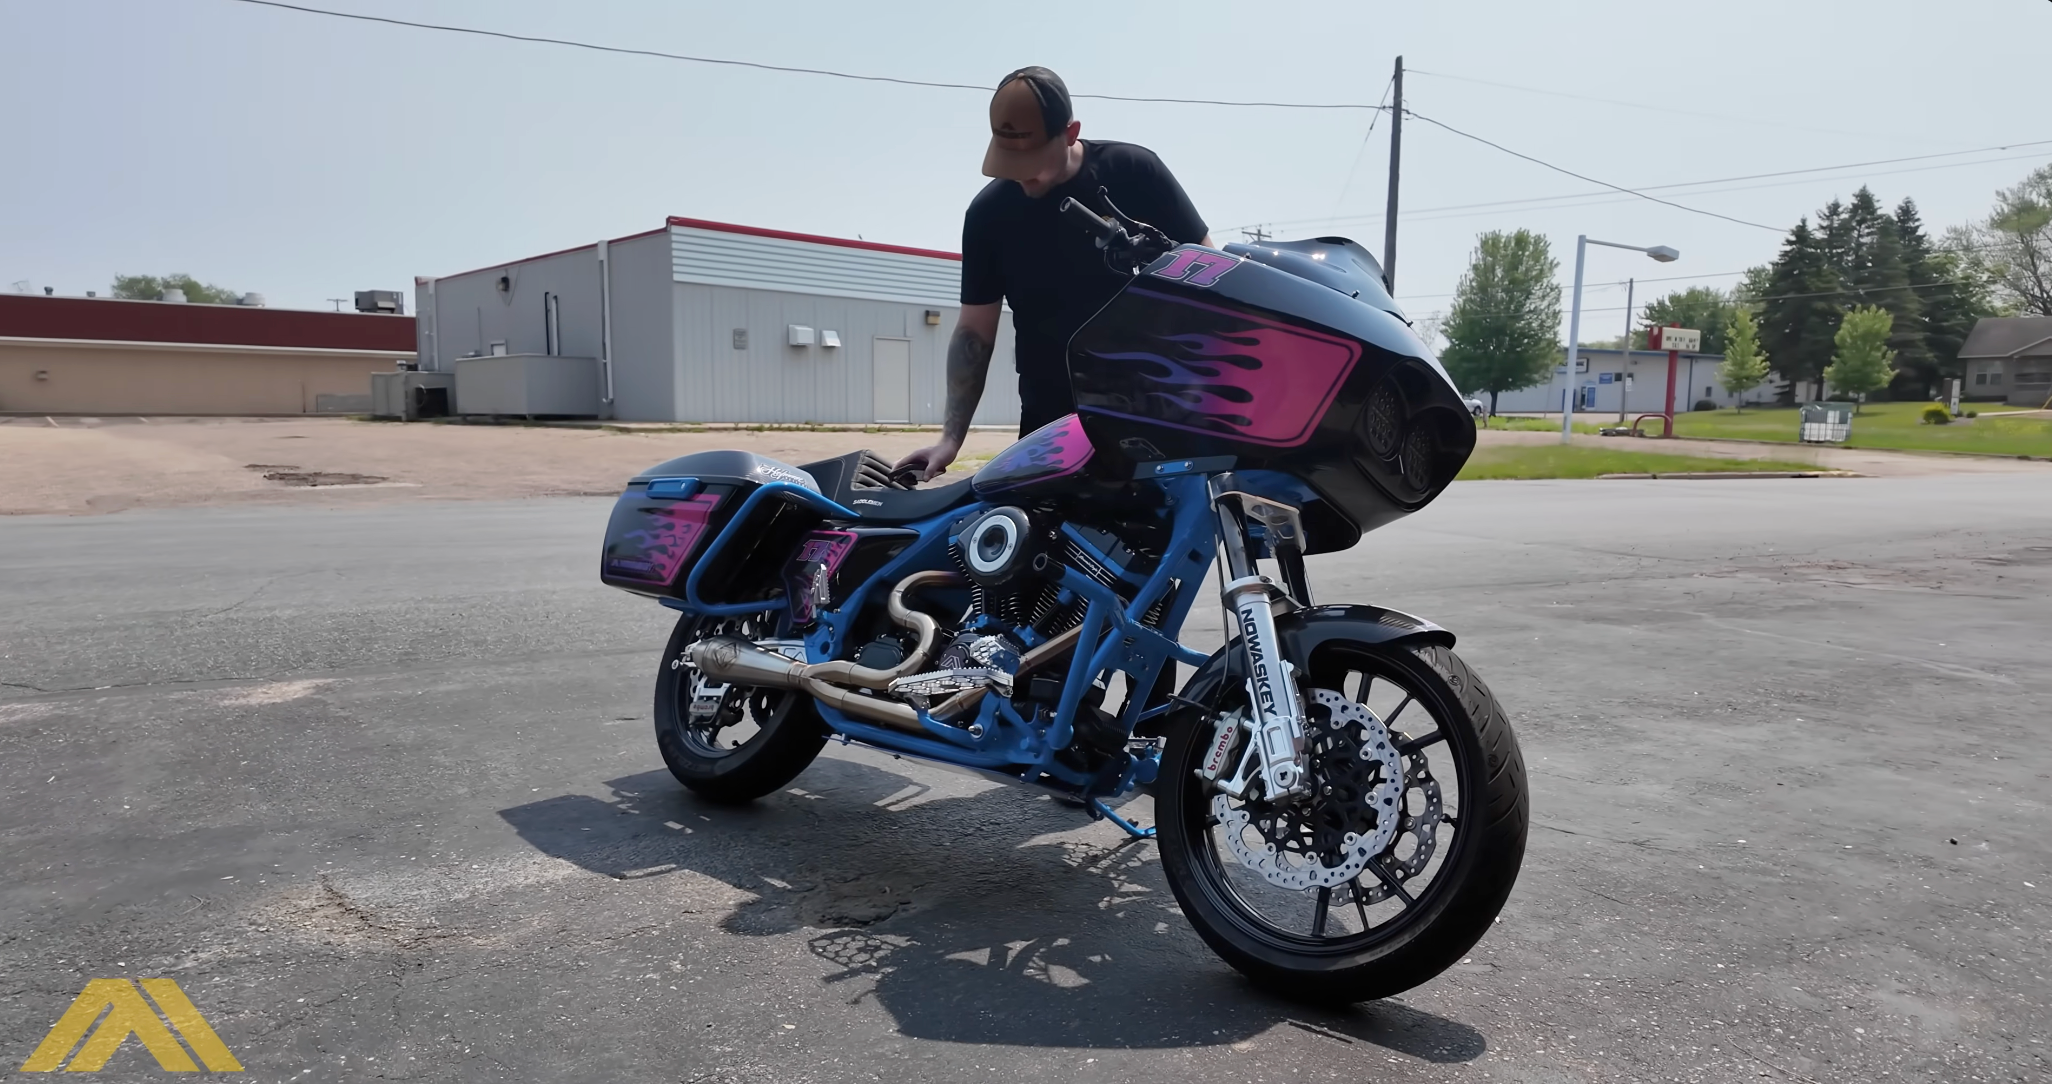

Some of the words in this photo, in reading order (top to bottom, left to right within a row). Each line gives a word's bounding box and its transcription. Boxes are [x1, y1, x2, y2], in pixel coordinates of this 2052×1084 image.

[1150, 248, 1244, 287] 17
[796, 539, 830, 562] 17
[1241, 608, 1277, 716] NOWASKEY
[1207, 726, 1233, 771] brembo
